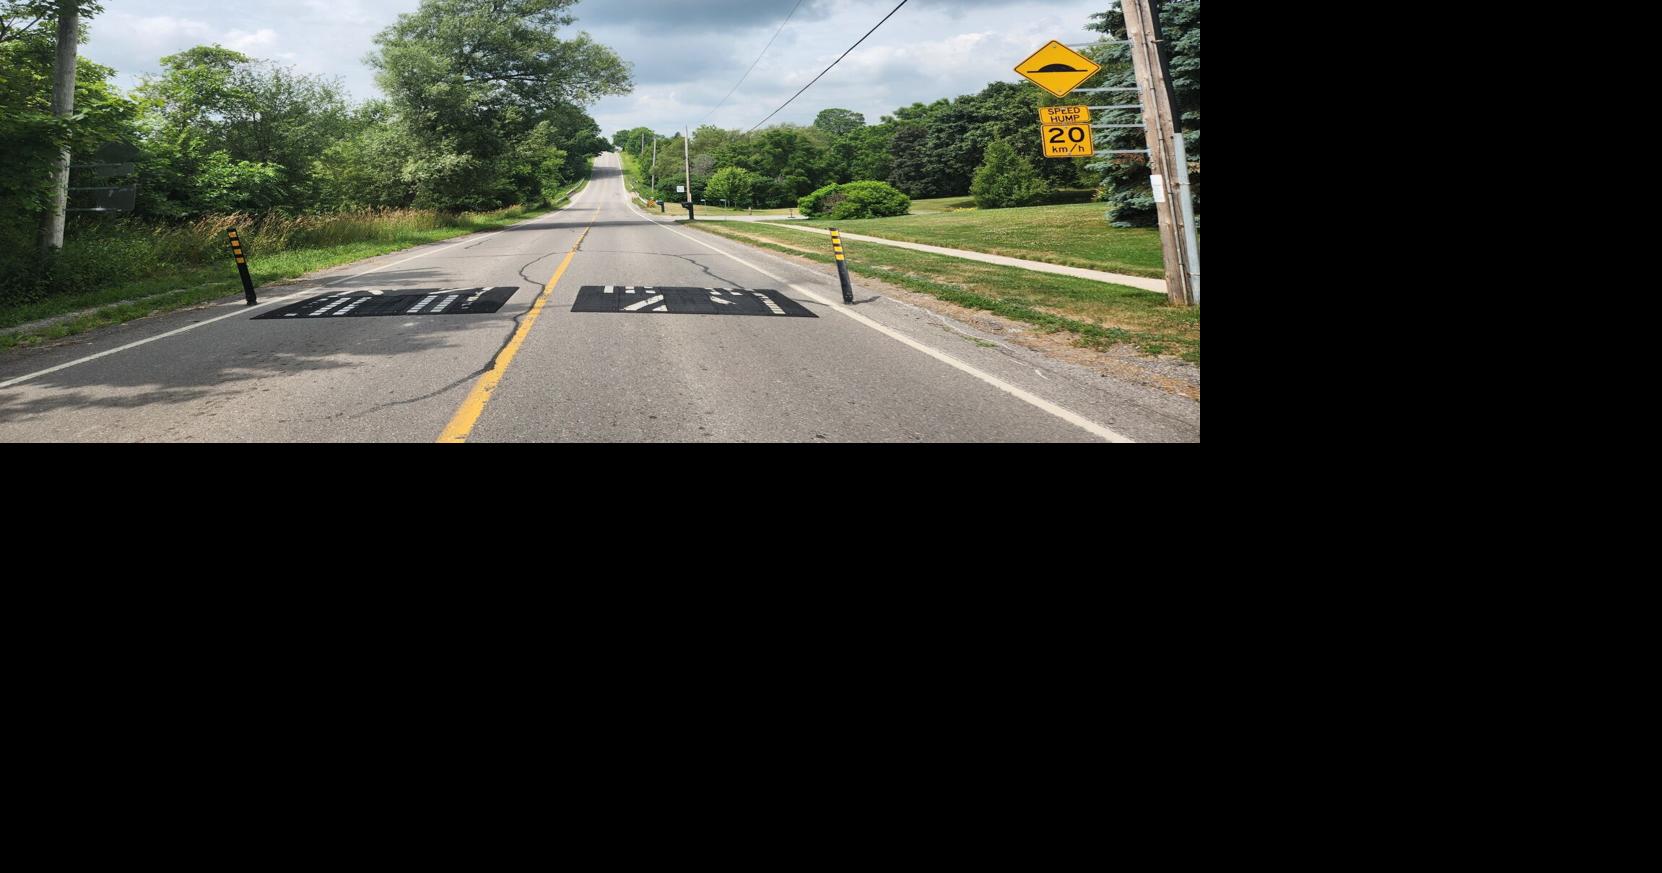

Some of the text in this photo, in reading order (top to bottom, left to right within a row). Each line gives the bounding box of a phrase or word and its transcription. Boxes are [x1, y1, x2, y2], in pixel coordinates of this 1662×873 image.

[1047, 107, 1081, 115] SPEED
[1050, 115, 1080, 123] HUMP
[1048, 127, 1085, 143] 20
[1052, 143, 1085, 153] km/h
